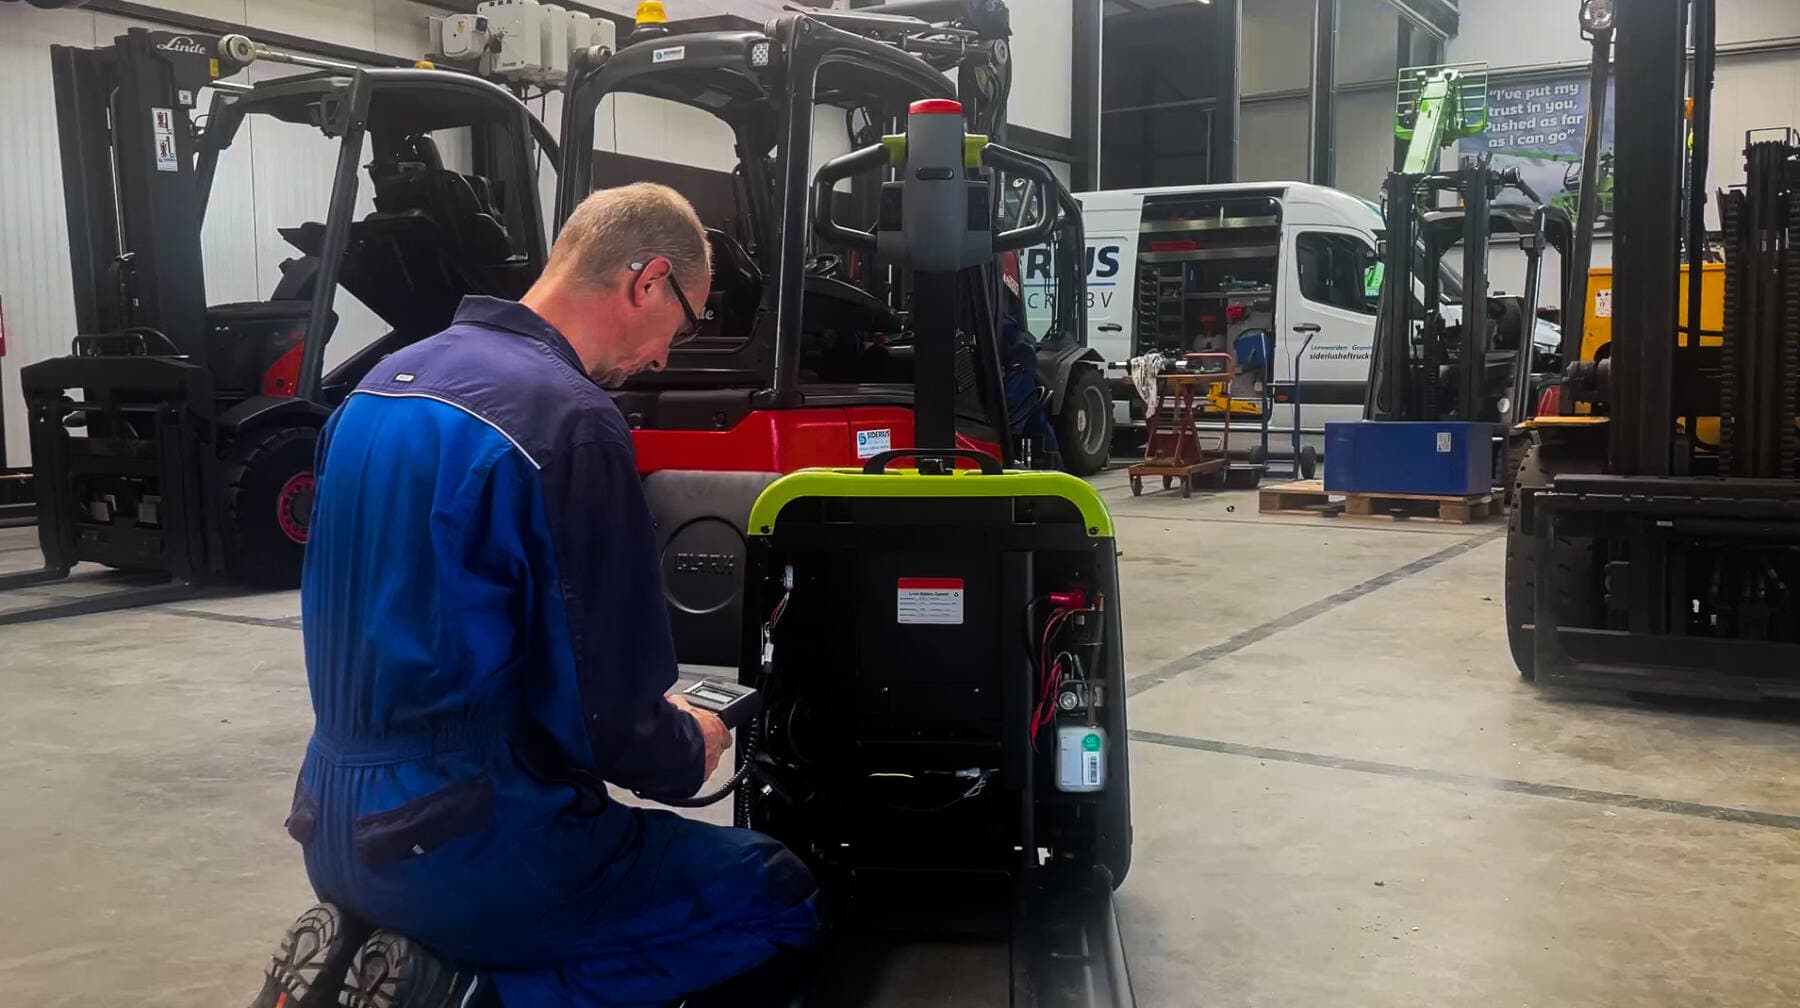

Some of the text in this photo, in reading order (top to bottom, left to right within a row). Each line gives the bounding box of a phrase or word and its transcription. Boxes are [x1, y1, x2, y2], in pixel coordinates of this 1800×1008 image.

[157, 36, 207, 55] Linde
[1526, 84, 1551, 99] put
[1555, 84, 1579, 95] my
[1489, 100, 1577, 116] trust in you,
[1540, 117, 1558, 127] as
[1561, 114, 1583, 125] far
[1489, 138, 1505, 148] as
[1518, 134, 1544, 145] can
